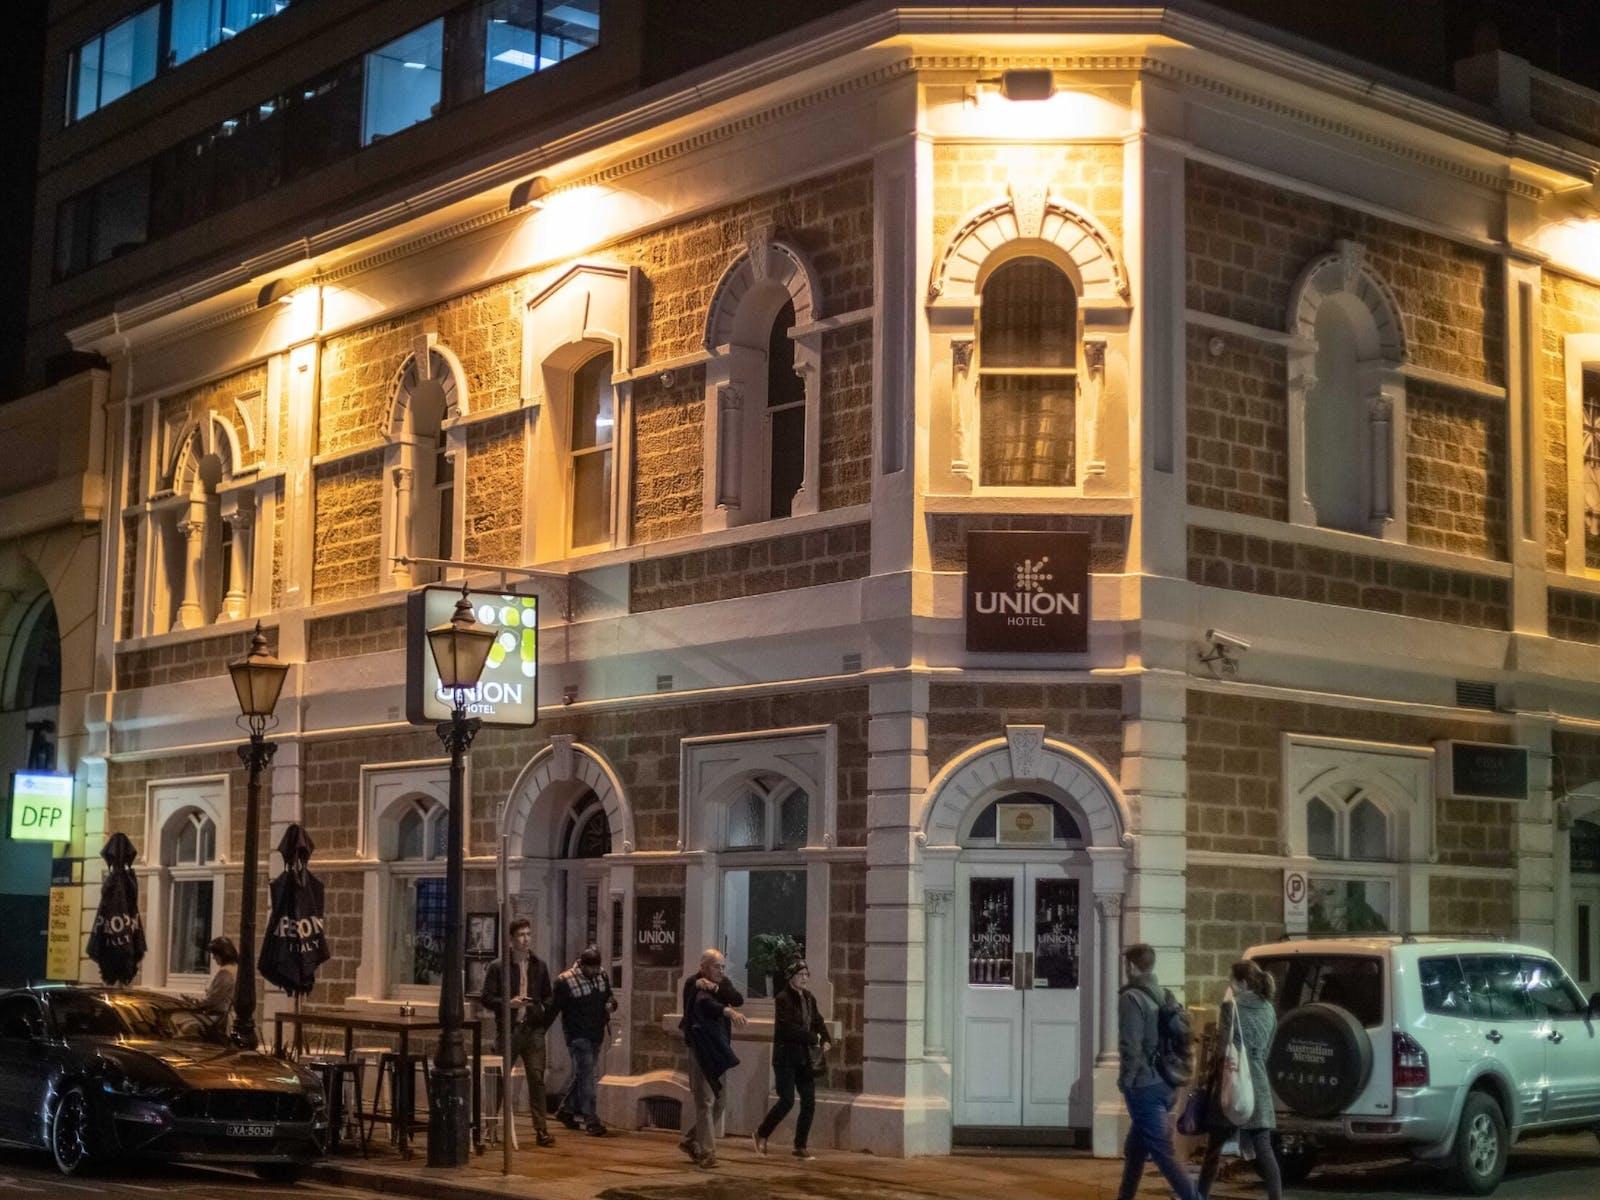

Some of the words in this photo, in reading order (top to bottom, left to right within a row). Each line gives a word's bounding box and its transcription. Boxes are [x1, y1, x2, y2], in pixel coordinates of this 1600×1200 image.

[974, 591, 1080, 615] UNION
[1007, 616, 1045, 626] HOTEL
[21, 805, 63, 828] DFP
[638, 930, 675, 944] UNION
[972, 933, 1011, 943] UNION
[1037, 934, 1077, 944] UNION
[1277, 1071, 1339, 1086] PAJERO
